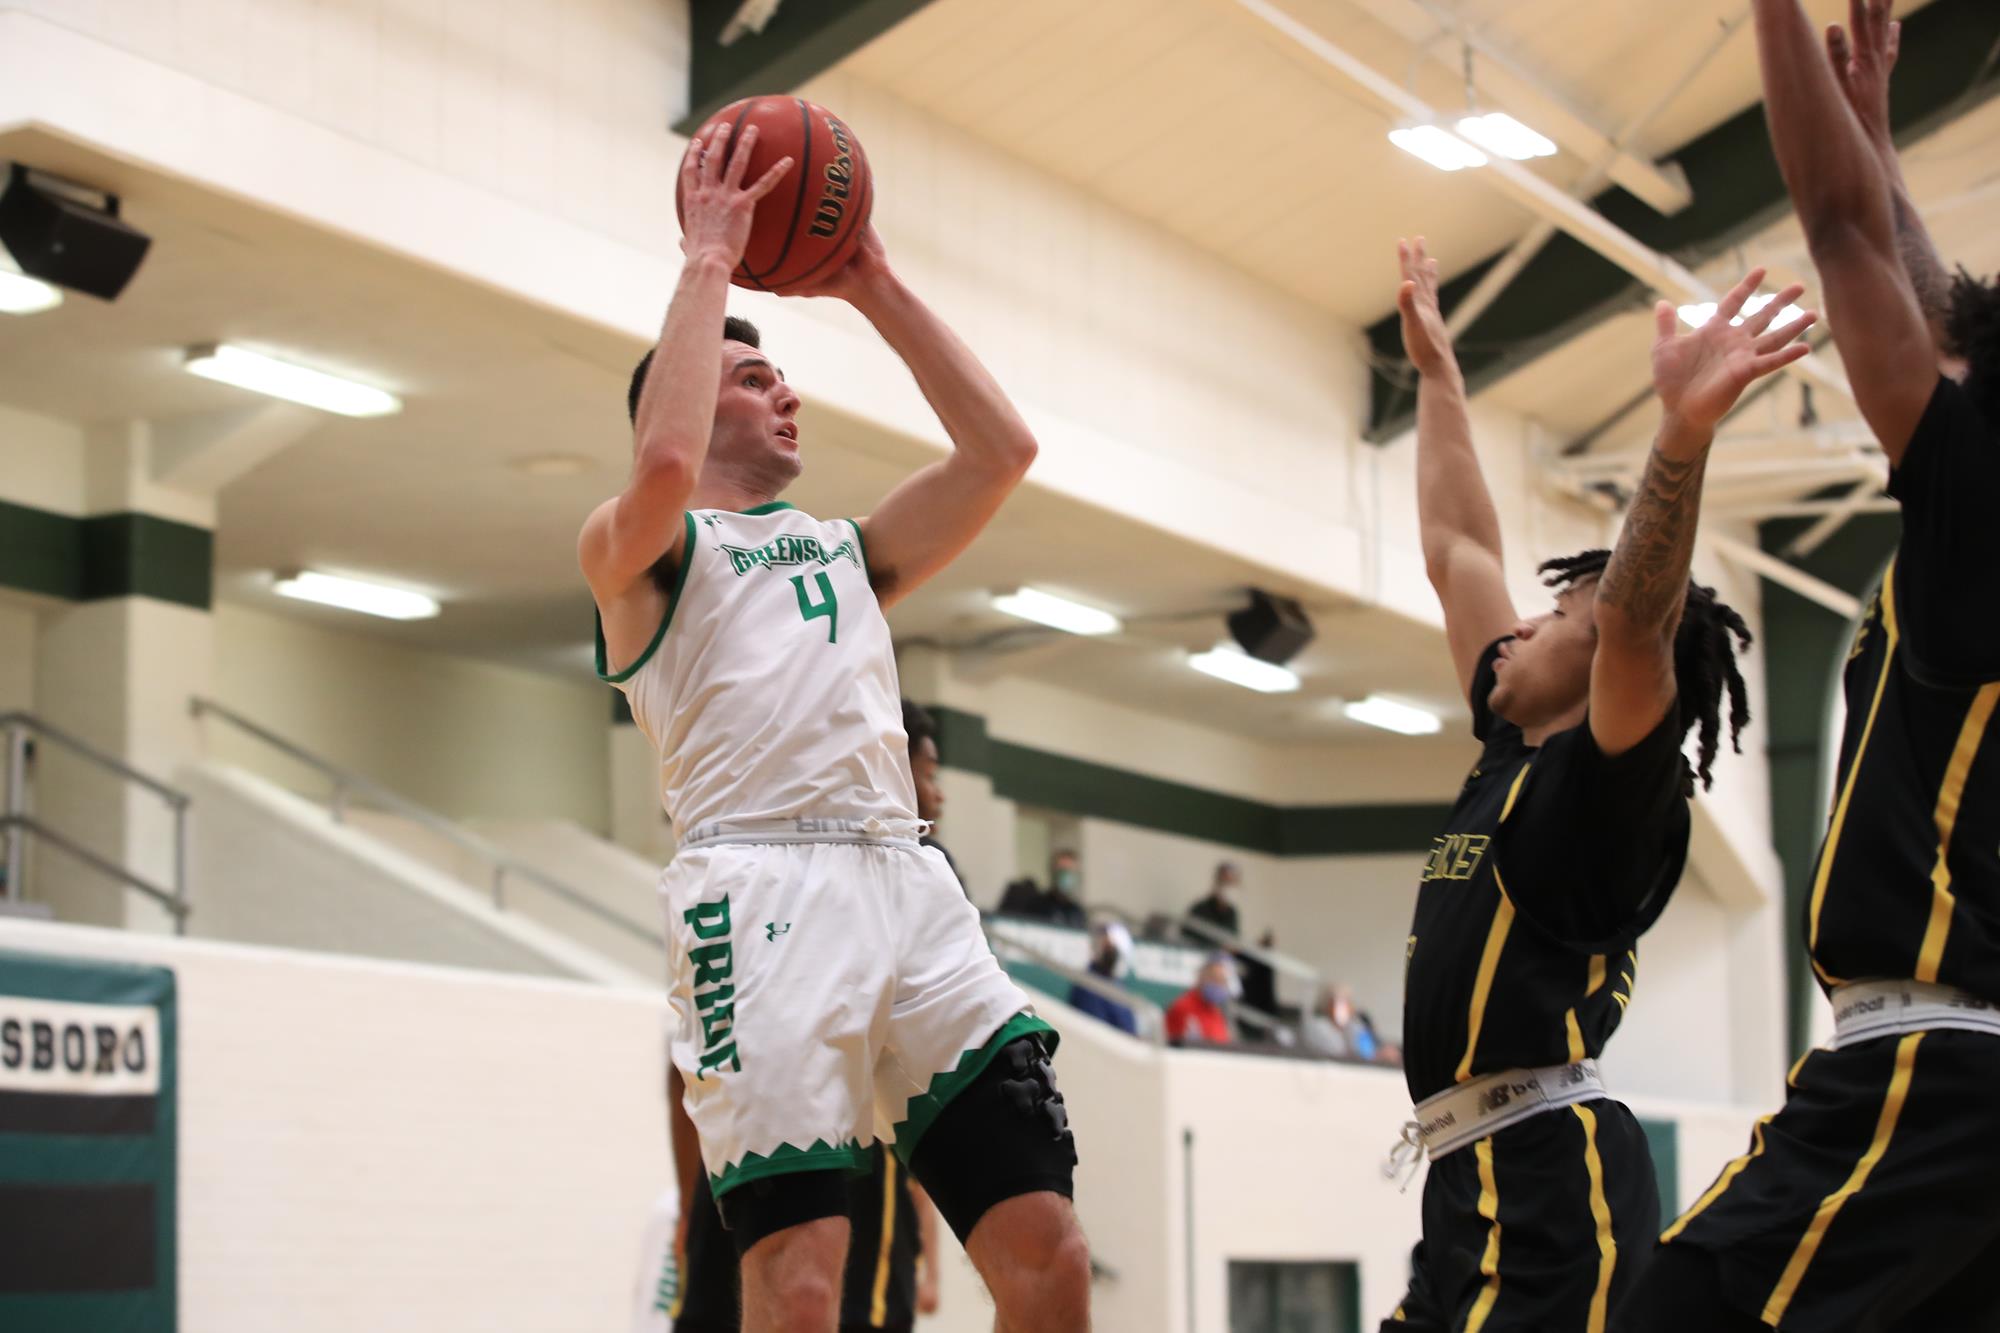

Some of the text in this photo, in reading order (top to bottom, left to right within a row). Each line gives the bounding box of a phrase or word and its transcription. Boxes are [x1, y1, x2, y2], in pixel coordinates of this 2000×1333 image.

[808, 115, 853, 239] Wilson
[789, 571, 838, 644] 4
[0, 1018, 147, 1074] SBORO
